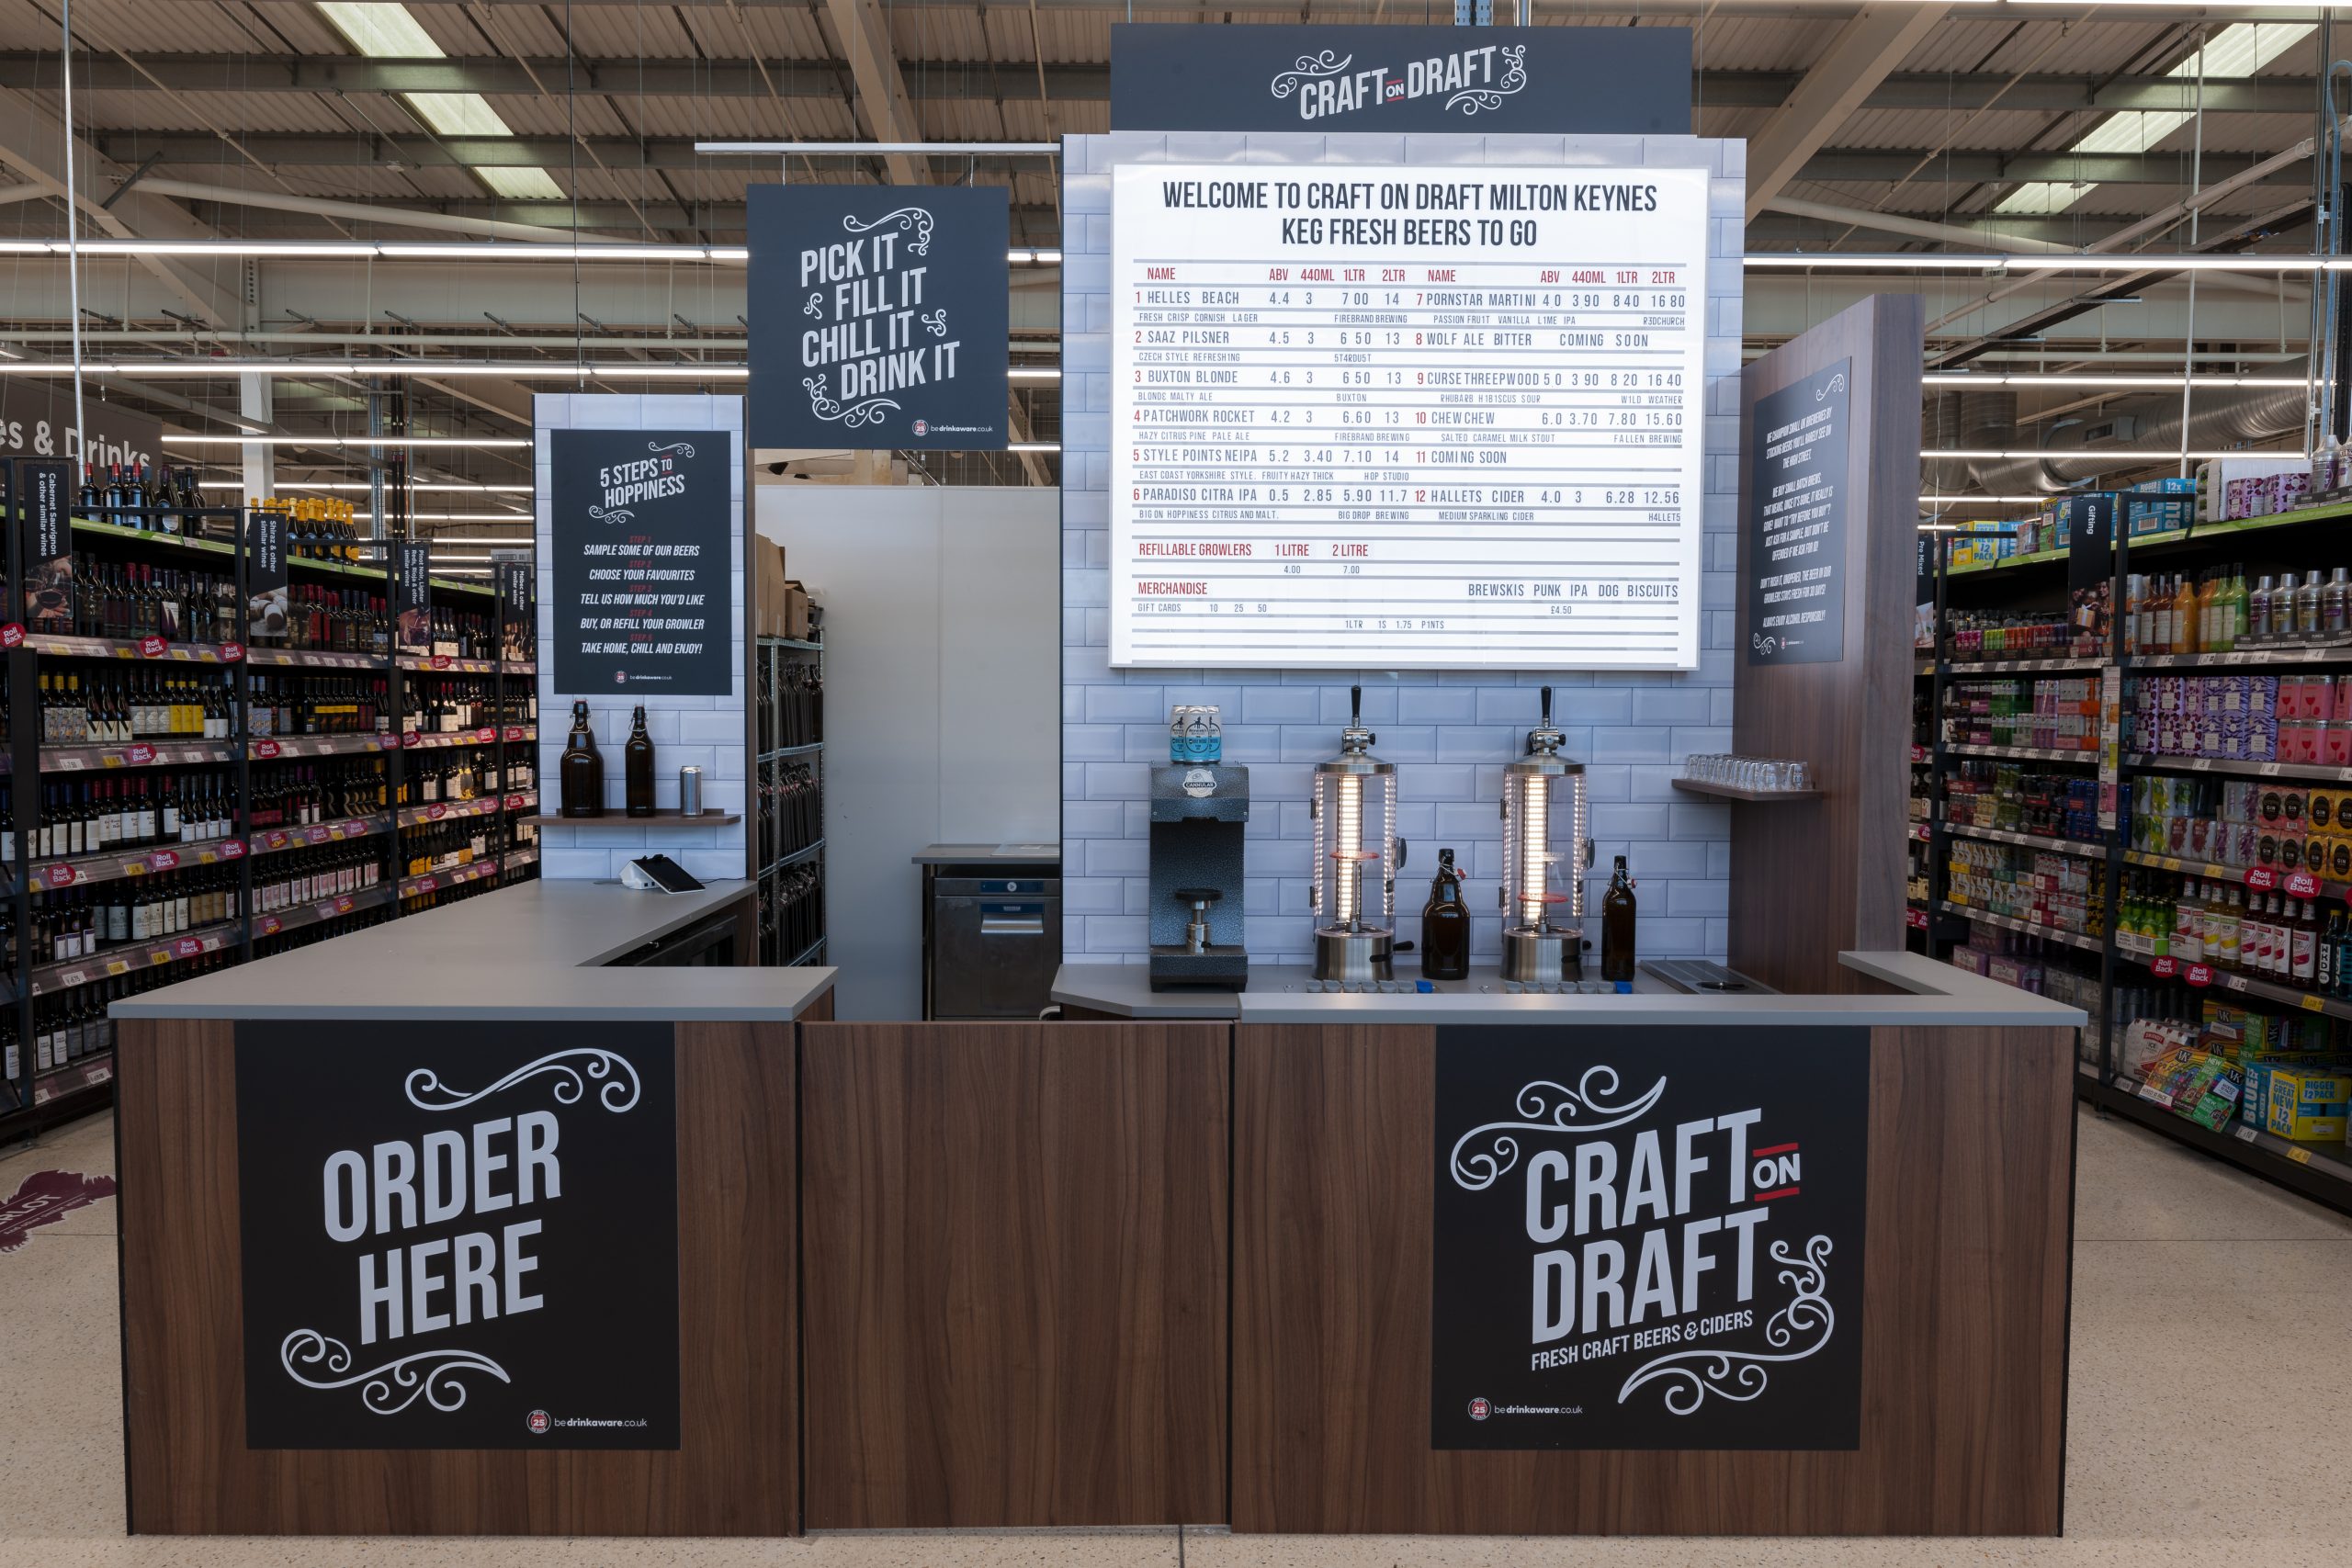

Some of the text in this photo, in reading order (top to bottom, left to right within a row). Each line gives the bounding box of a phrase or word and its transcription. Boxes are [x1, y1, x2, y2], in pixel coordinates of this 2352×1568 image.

[1300, 45, 1497, 119] CRAFT ON DRAFT
[1163, 182, 1657, 212] WELCOME TO CRAFT ON DRAFT MILTON KEYNES
[1282, 220, 1537, 247] KEG FRESH BEERS TO GO
[802, 232, 898, 288] PICK IT
[1148, 268, 1405, 281] NAME ABV 440ML 1LTR 2LTR
[836, 267, 926, 321] FILL IT
[1136, 291, 1399, 305] 1 HELLES BEACH 4.4 3 14
[803, 310, 913, 367] CHILL IT
[1136, 331, 1289, 344] 2 SAAZ PILSNER 4.5
[842, 341, 960, 400] DRINK IT
[1148, 371, 1238, 383] BUXTON BLONDE
[1143, 411, 1255, 423] PATCHWORK ROCKET
[34, 421, 53, 456] &
[1143, 449, 1221, 461] STYLE POINTS
[1431, 451, 1507, 463] COMING SOON
[601, 458, 673, 487] 5 STEPS TO
[605, 474, 685, 508] HOPPINESS
[1143, 489, 1257, 502] PARADISO CITRA IPA
[1431, 491, 1523, 502] HALLETS CIDER
[2086, 505, 2096, 535] Gifting
[49, 513, 57, 555] Sauvignon
[584, 545, 700, 556] SAMPLE SOME OF OUR BEERS
[1139, 544, 1251, 556] REFILLABLE GROWLERS
[1275, 545, 1309, 557] 1 LITRE
[1332, 545, 1368, 557] 2 LITRE
[589, 570, 695, 581] CHOOSE YOUR FAVOURITES
[1138, 582, 1207, 594] MERCHANDISE
[1468, 584, 1678, 597] BREWSKIS PUNK IPA DOG BISCUITS
[581, 594, 599, 604] TELL
[602, 594, 612, 604] US
[614, 594, 632, 604] HOW
[634, 594, 658, 604] MUCH
[686, 595, 704, 605] LIKE
[581, 618, 704, 630] BUY, OR REFILL YOUR GROWLER
[145, 639, 160, 649] Roll
[145, 645, 164, 654] Back
[582, 643, 702, 654] TAKE HOME, CHILL AND ENJOY!
[2294, 876, 2312, 886] Roll
[2290, 884, 2315, 894] Back
[2274, 1085, 2294, 1096] GREAT
[2305, 1081, 2335, 1089] BIGGER
[2304, 1090, 2335, 1099] 12 PACK
[2274, 1094, 2294, 1110] NEW
[2278, 1109, 2289, 1122] 12
[2271, 1120, 2292, 1134] PACK
[323, 1111, 560, 1242] ORDER
[1526, 1108, 1800, 1243] CRAFT ON
[359, 1219, 543, 1345] HERE
[1532, 1207, 1769, 1344] DRAFT
[1532, 1310, 1753, 1371] FRESH CRAFT BEERS & CIDERS
[1474, 1405, 1486, 1414] 25
